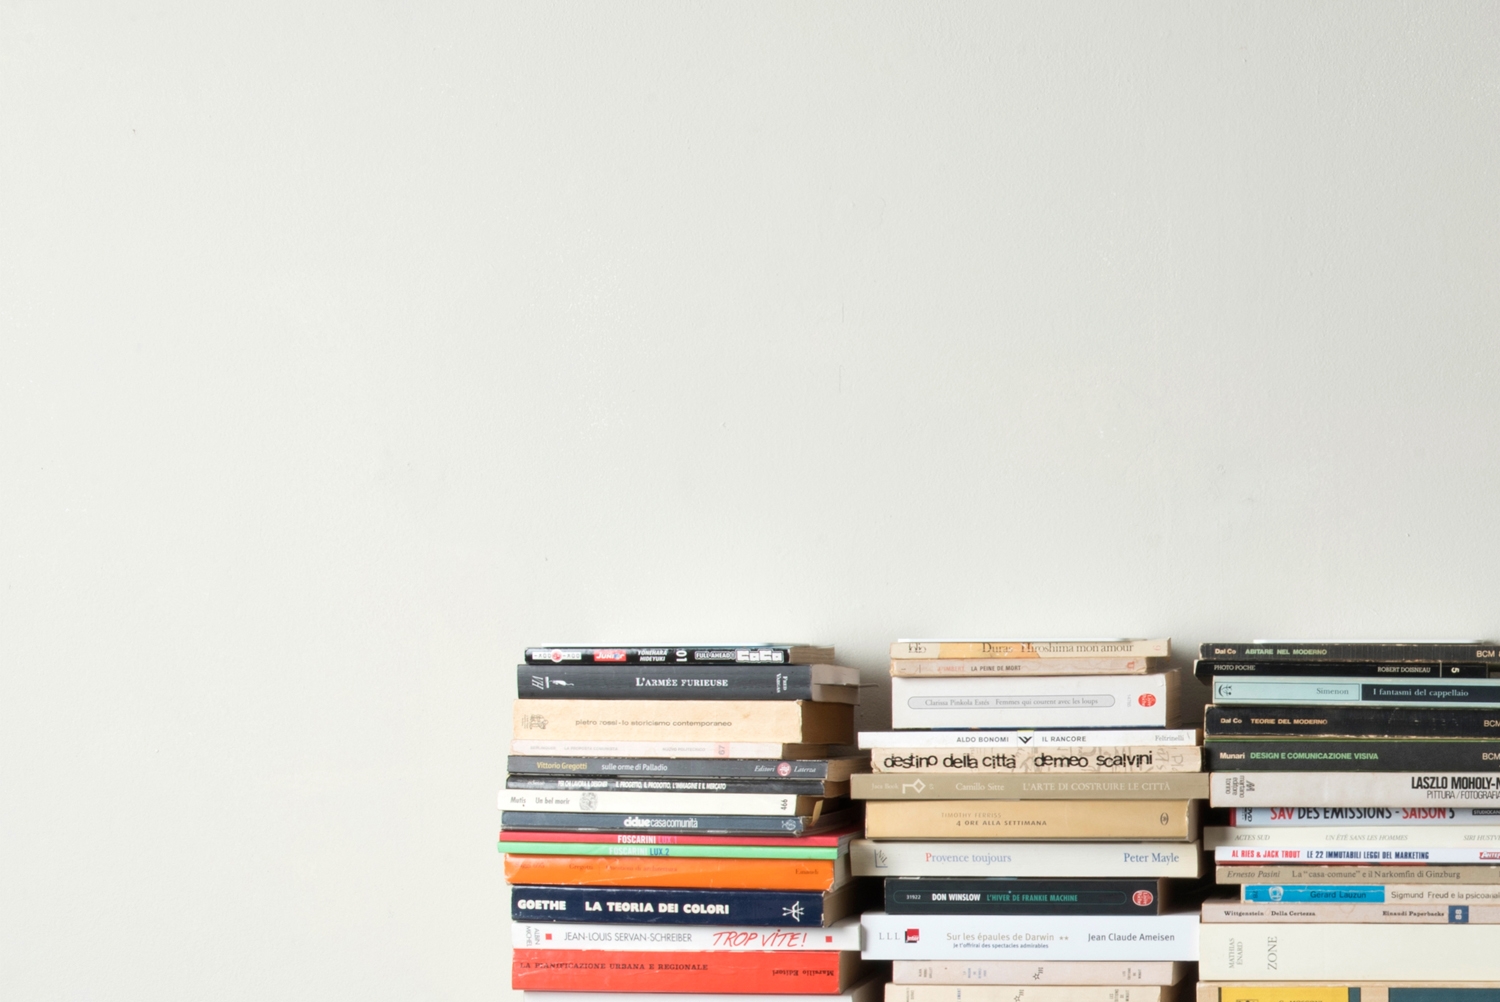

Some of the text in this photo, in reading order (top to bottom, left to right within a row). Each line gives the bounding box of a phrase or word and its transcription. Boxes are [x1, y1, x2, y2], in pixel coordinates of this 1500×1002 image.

[681, 678, 729, 687] FURIEUSE
[1316, 687, 1349, 696] Simenon
[1373, 688, 1469, 699] I fantasmi del cappellaio
[884, 752, 1016, 770] destino della città
[1034, 750, 1153, 768] demeo scalvini
[1411, 777, 1448, 790] LASZLO
[925, 853, 1012, 865] Provence toujours
[1123, 853, 1180, 865] Peter Mayle
[932, 893, 981, 902] DON WINSLOW
[517, 900, 567, 911] GOETHE
[585, 902, 729, 915] LA TEORIA DEI COLORI
[564, 931, 692, 943] JEAN-LOUIS SERVAN-SCHREIBER
[712, 929, 807, 948] TROP VITE!
[1088, 933, 1175, 943] Jean Claude Ameisen
[1267, 936, 1278, 970] ZONE
